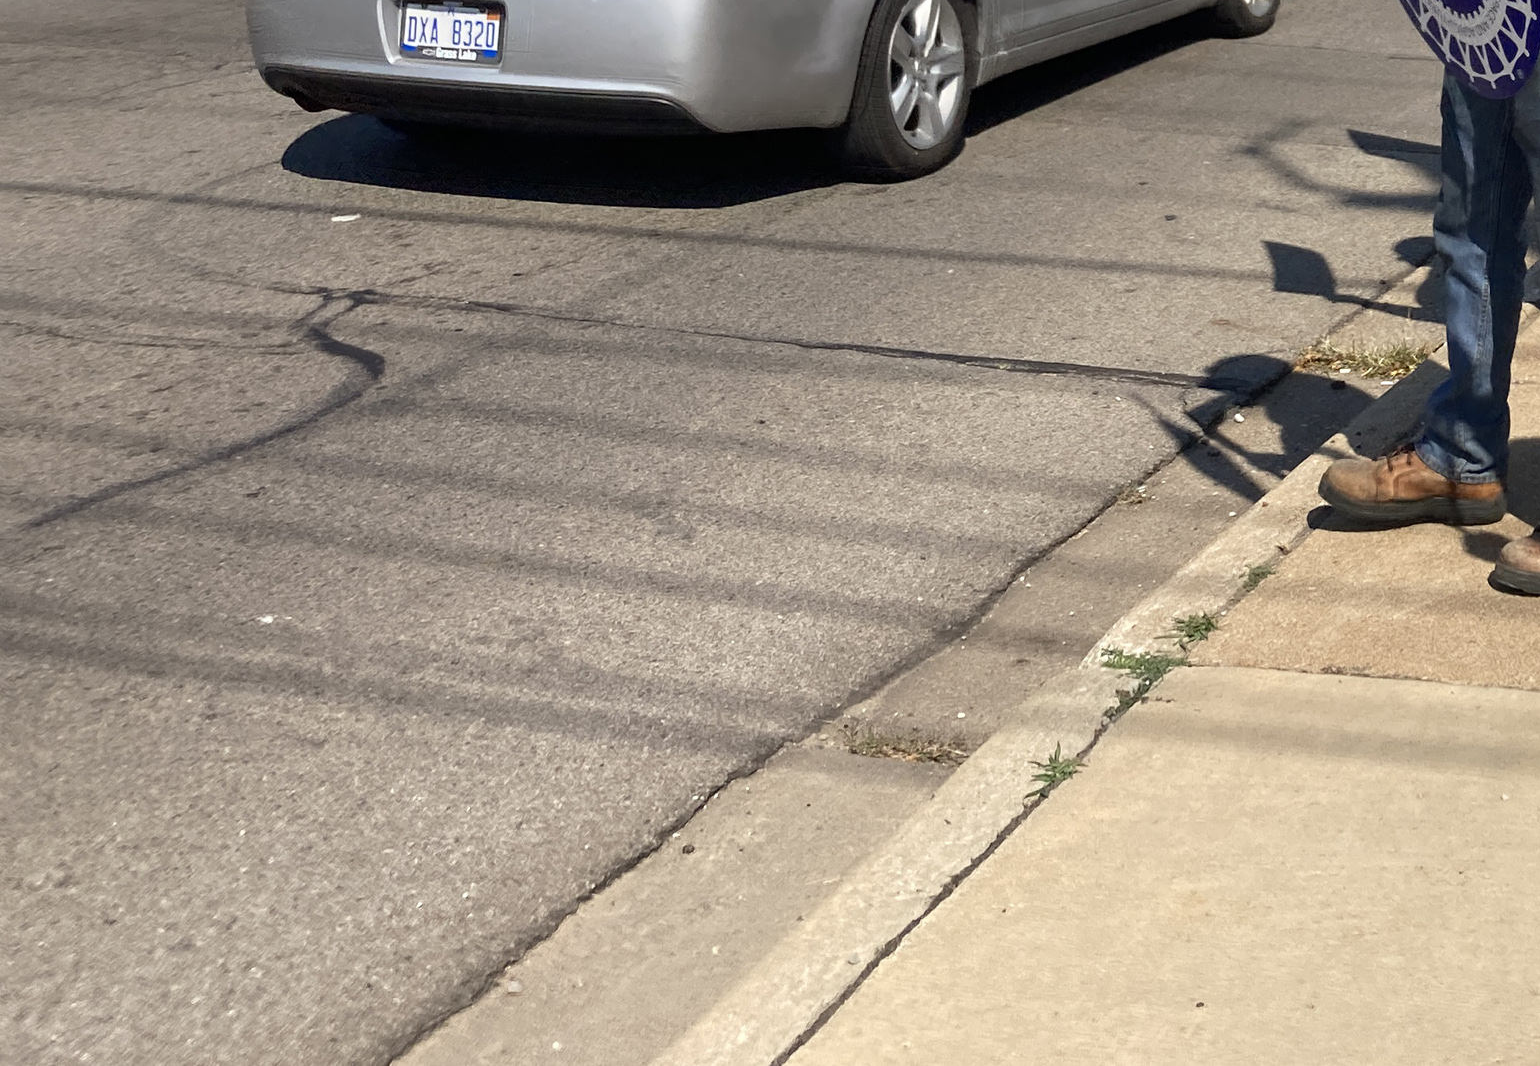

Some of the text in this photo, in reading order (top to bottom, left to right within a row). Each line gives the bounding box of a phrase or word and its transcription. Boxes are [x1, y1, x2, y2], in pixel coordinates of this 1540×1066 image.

[407, 15, 496, 48] DXA 8320
[458, 47, 477, 61] Lake
